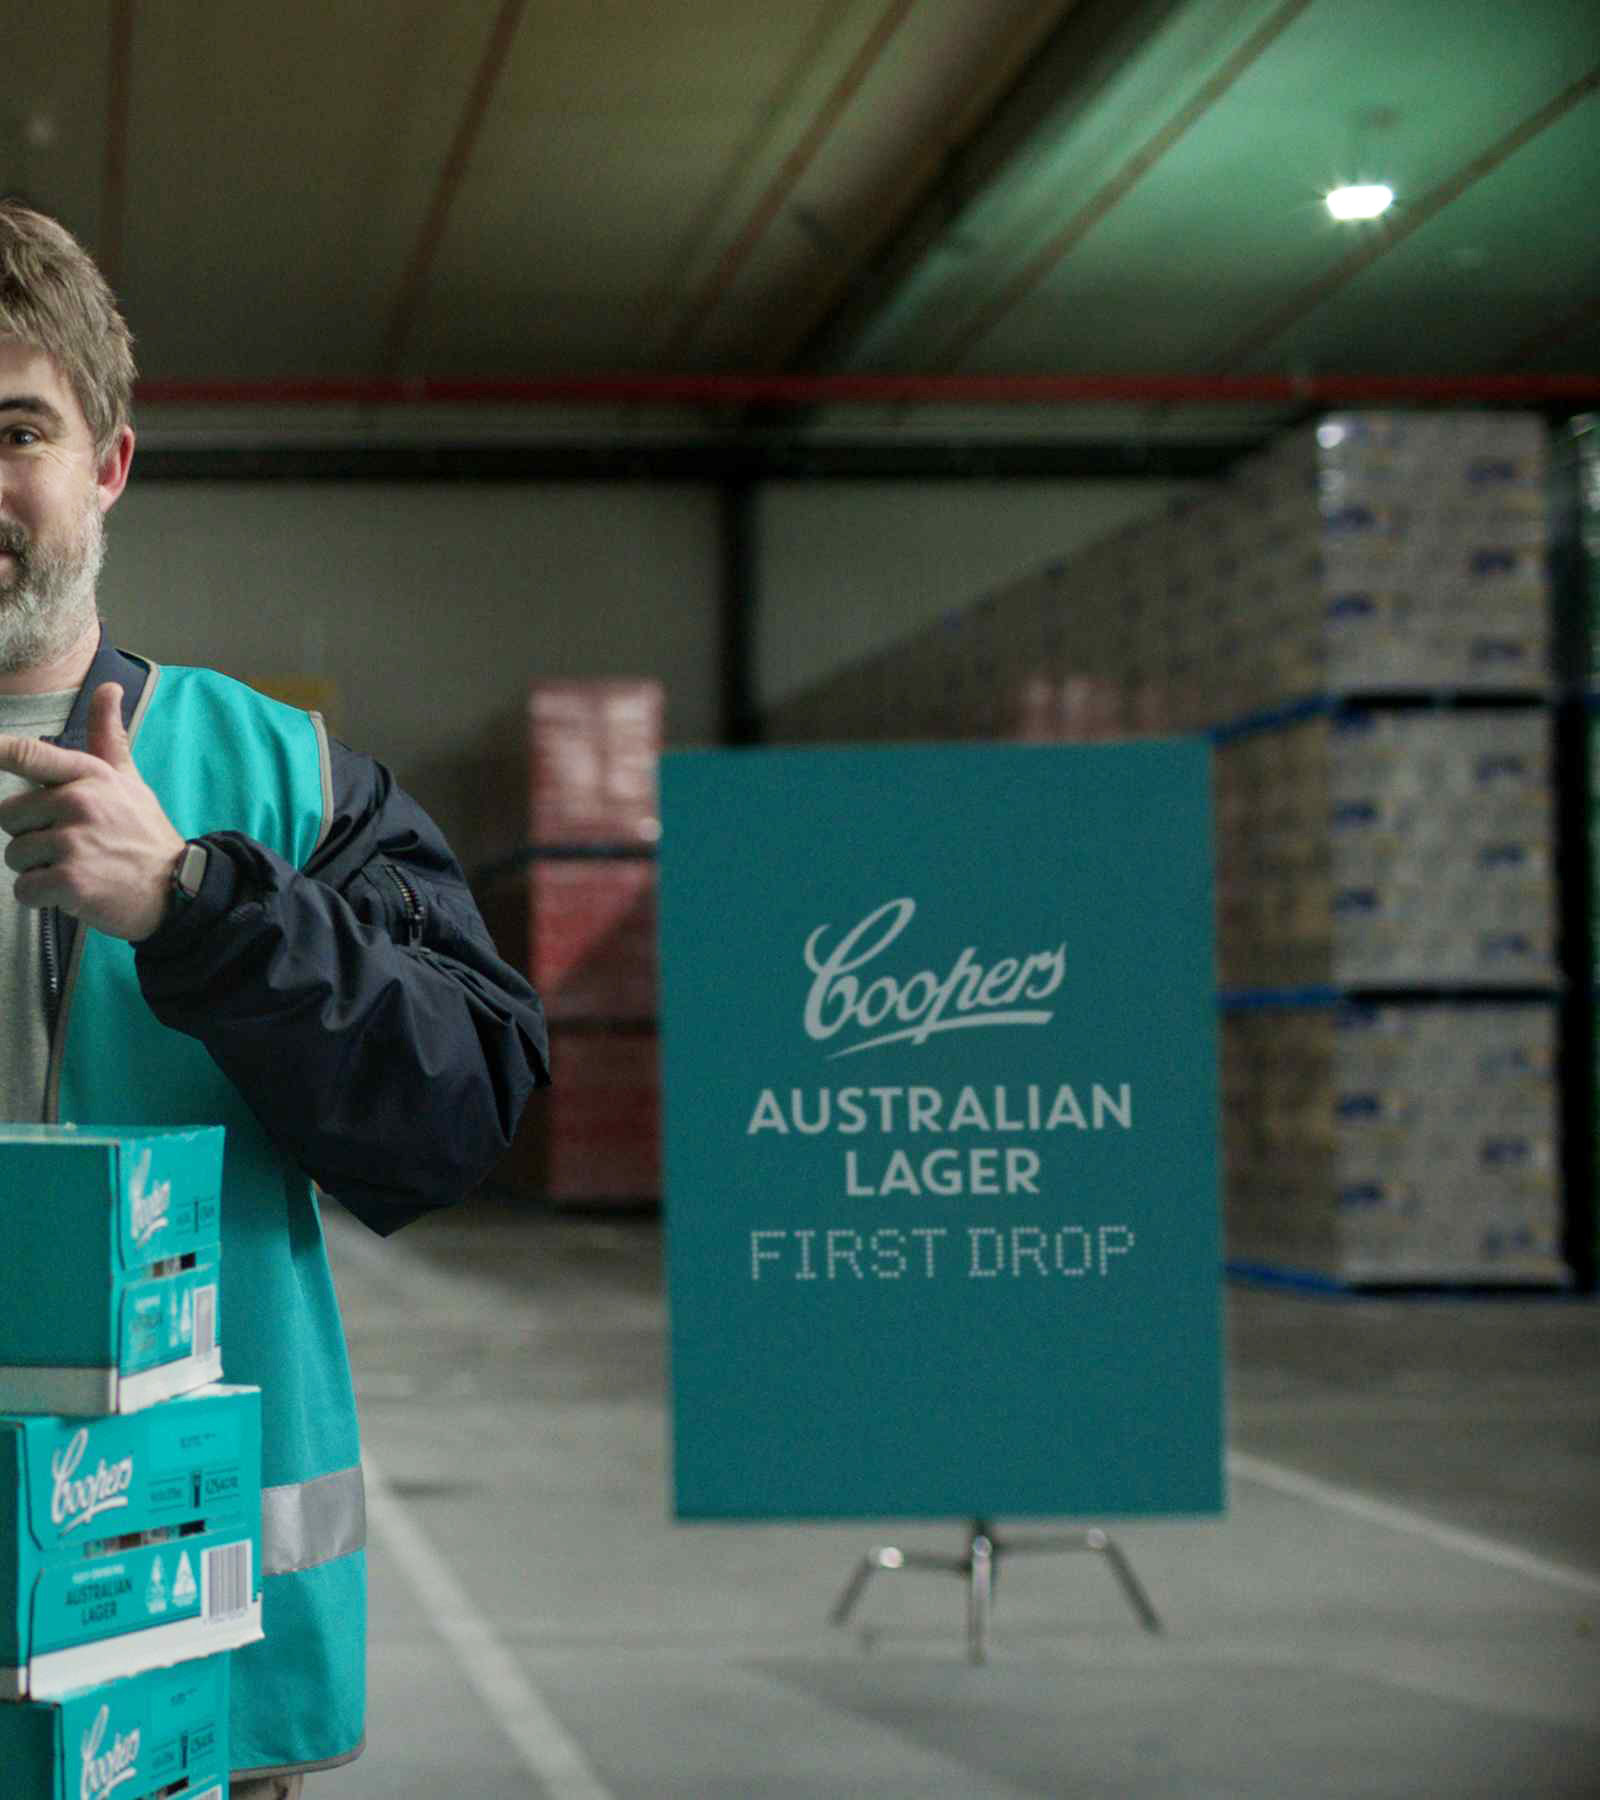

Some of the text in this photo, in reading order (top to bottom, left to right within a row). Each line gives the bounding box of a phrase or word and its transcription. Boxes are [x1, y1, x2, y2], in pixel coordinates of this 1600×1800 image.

[804, 898, 1067, 1060] Coopers
[746, 1083, 1134, 1136] AUSTRALIAN
[844, 1147, 1041, 1197] LAGER
[750, 1225, 1135, 1280] FIRST DROP
[51, 1428, 134, 1540] Coopers
[65, 1578, 133, 1606] AUSTRALIAN
[80, 1601, 118, 1626] LAGER
